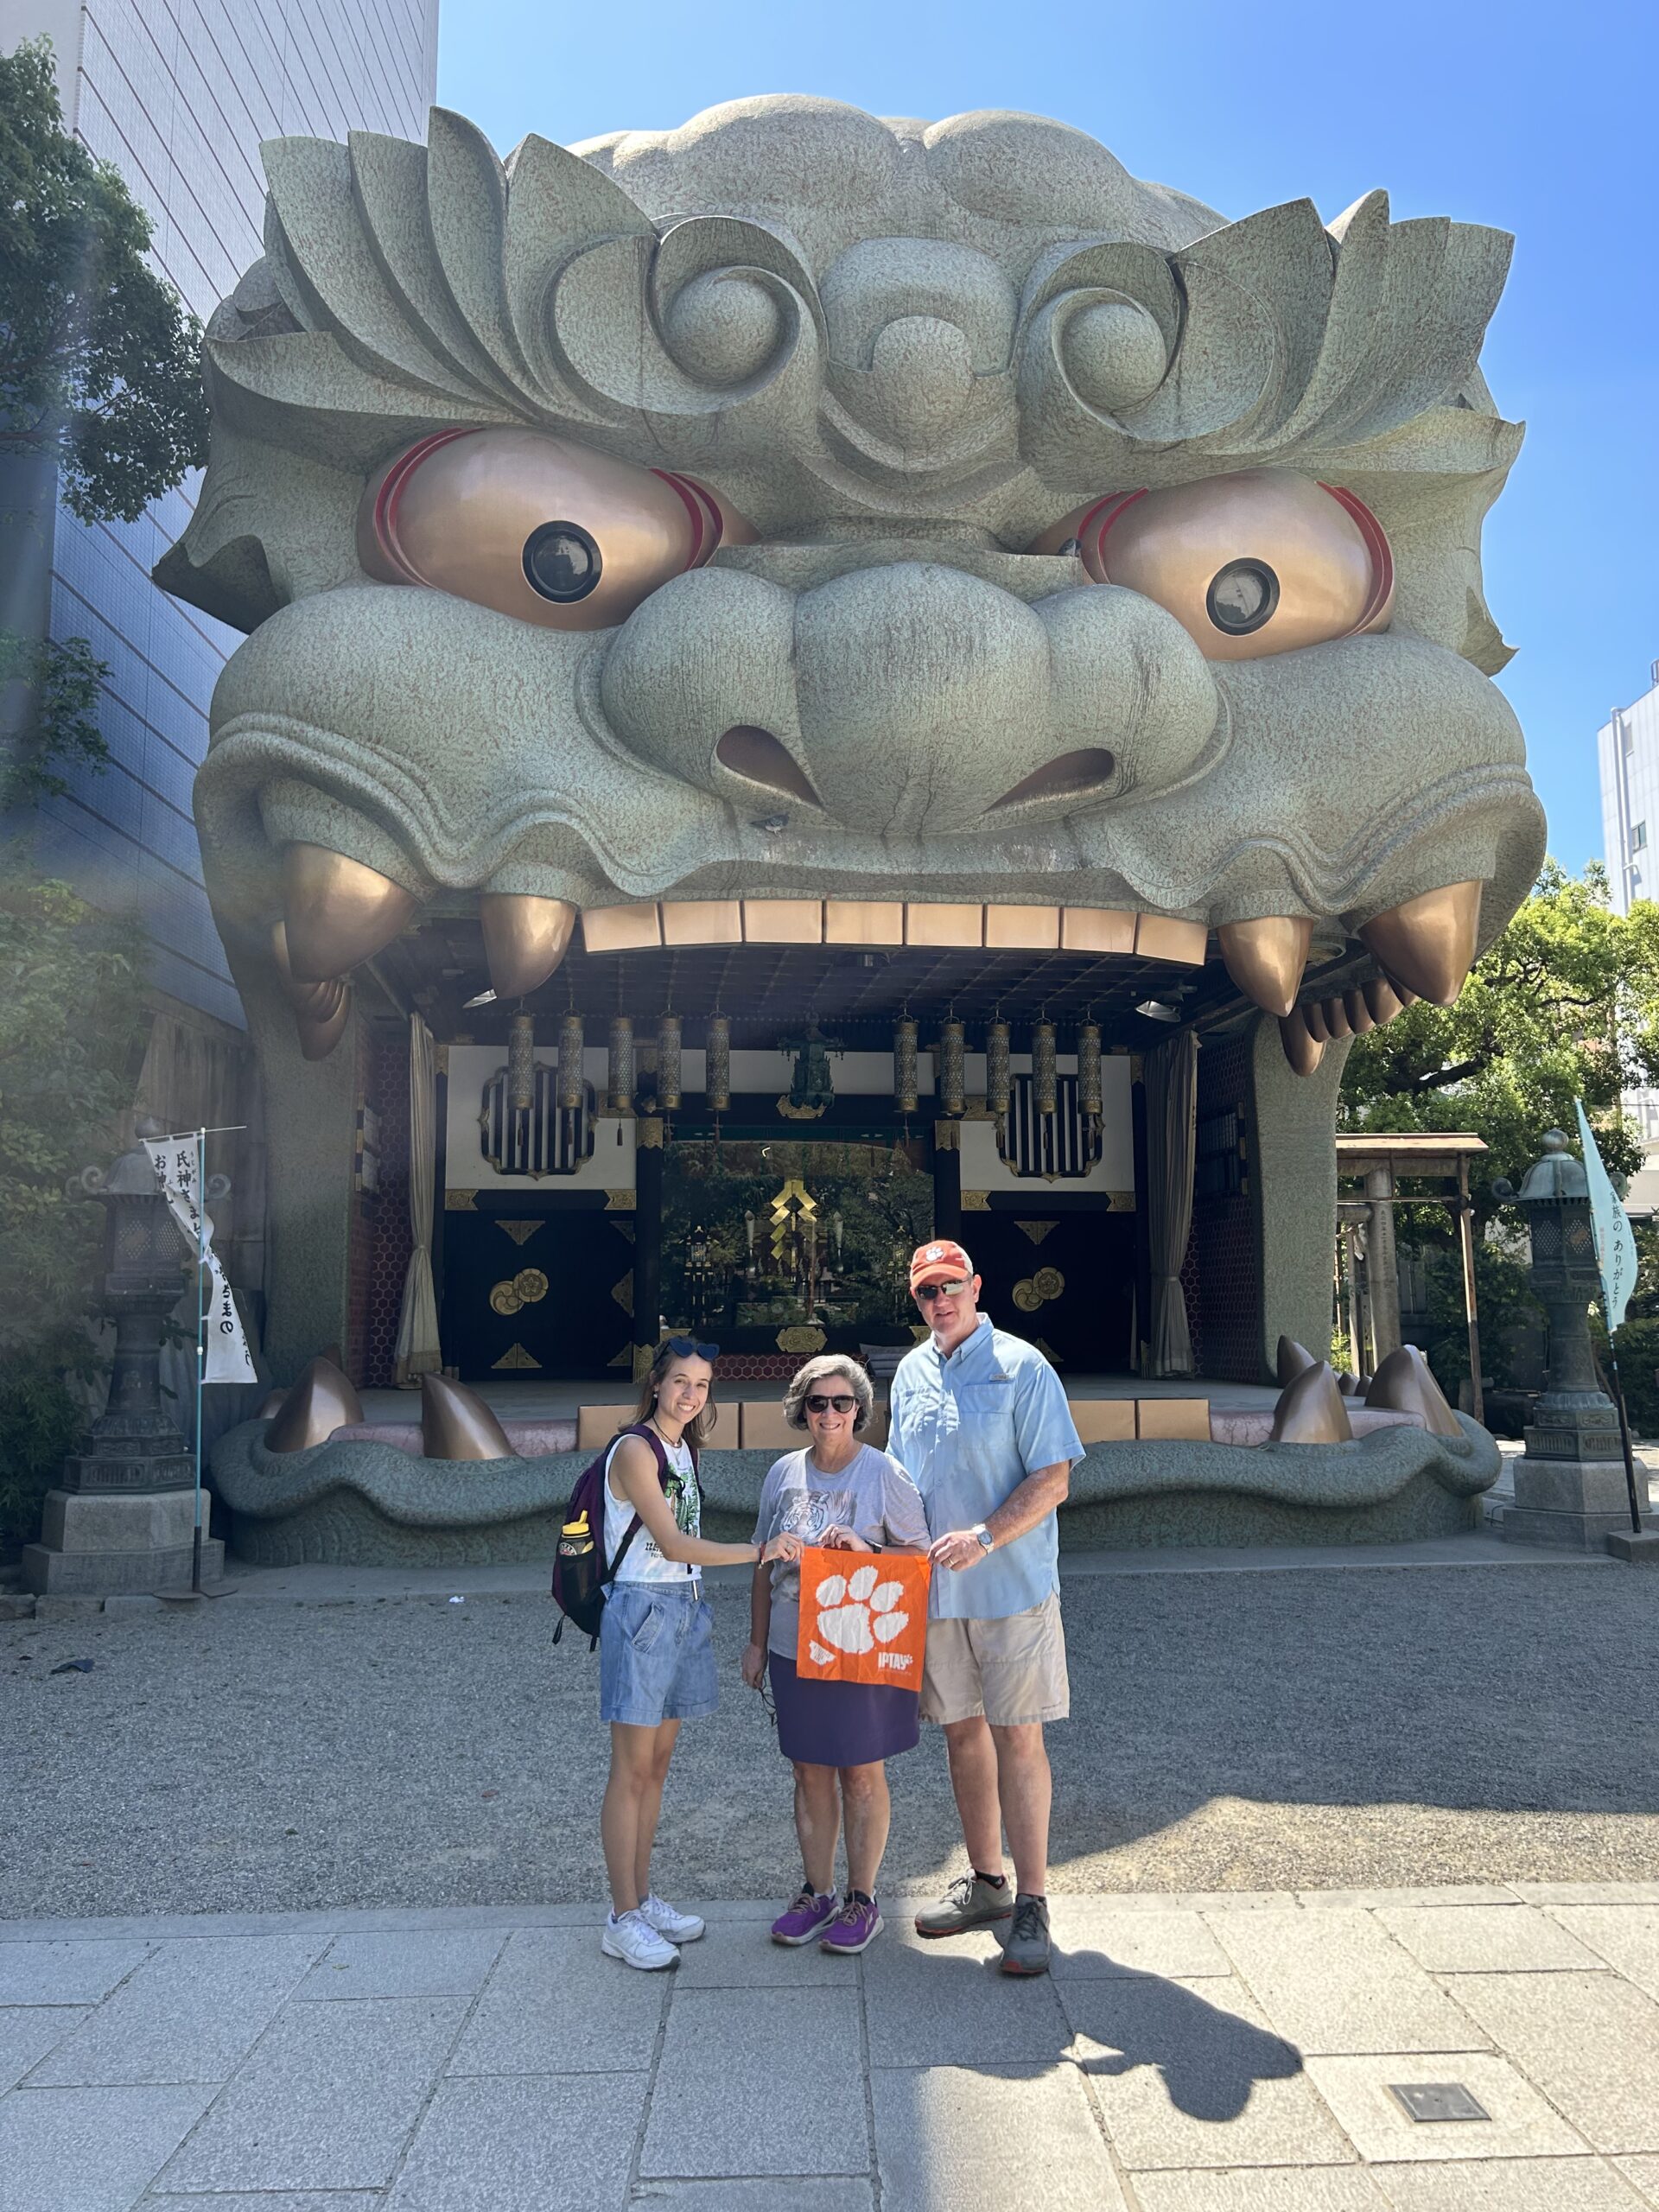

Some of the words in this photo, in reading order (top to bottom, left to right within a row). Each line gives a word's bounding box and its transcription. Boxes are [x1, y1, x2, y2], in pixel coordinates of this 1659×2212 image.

[1612, 1239, 1624, 1308] ありがとう
